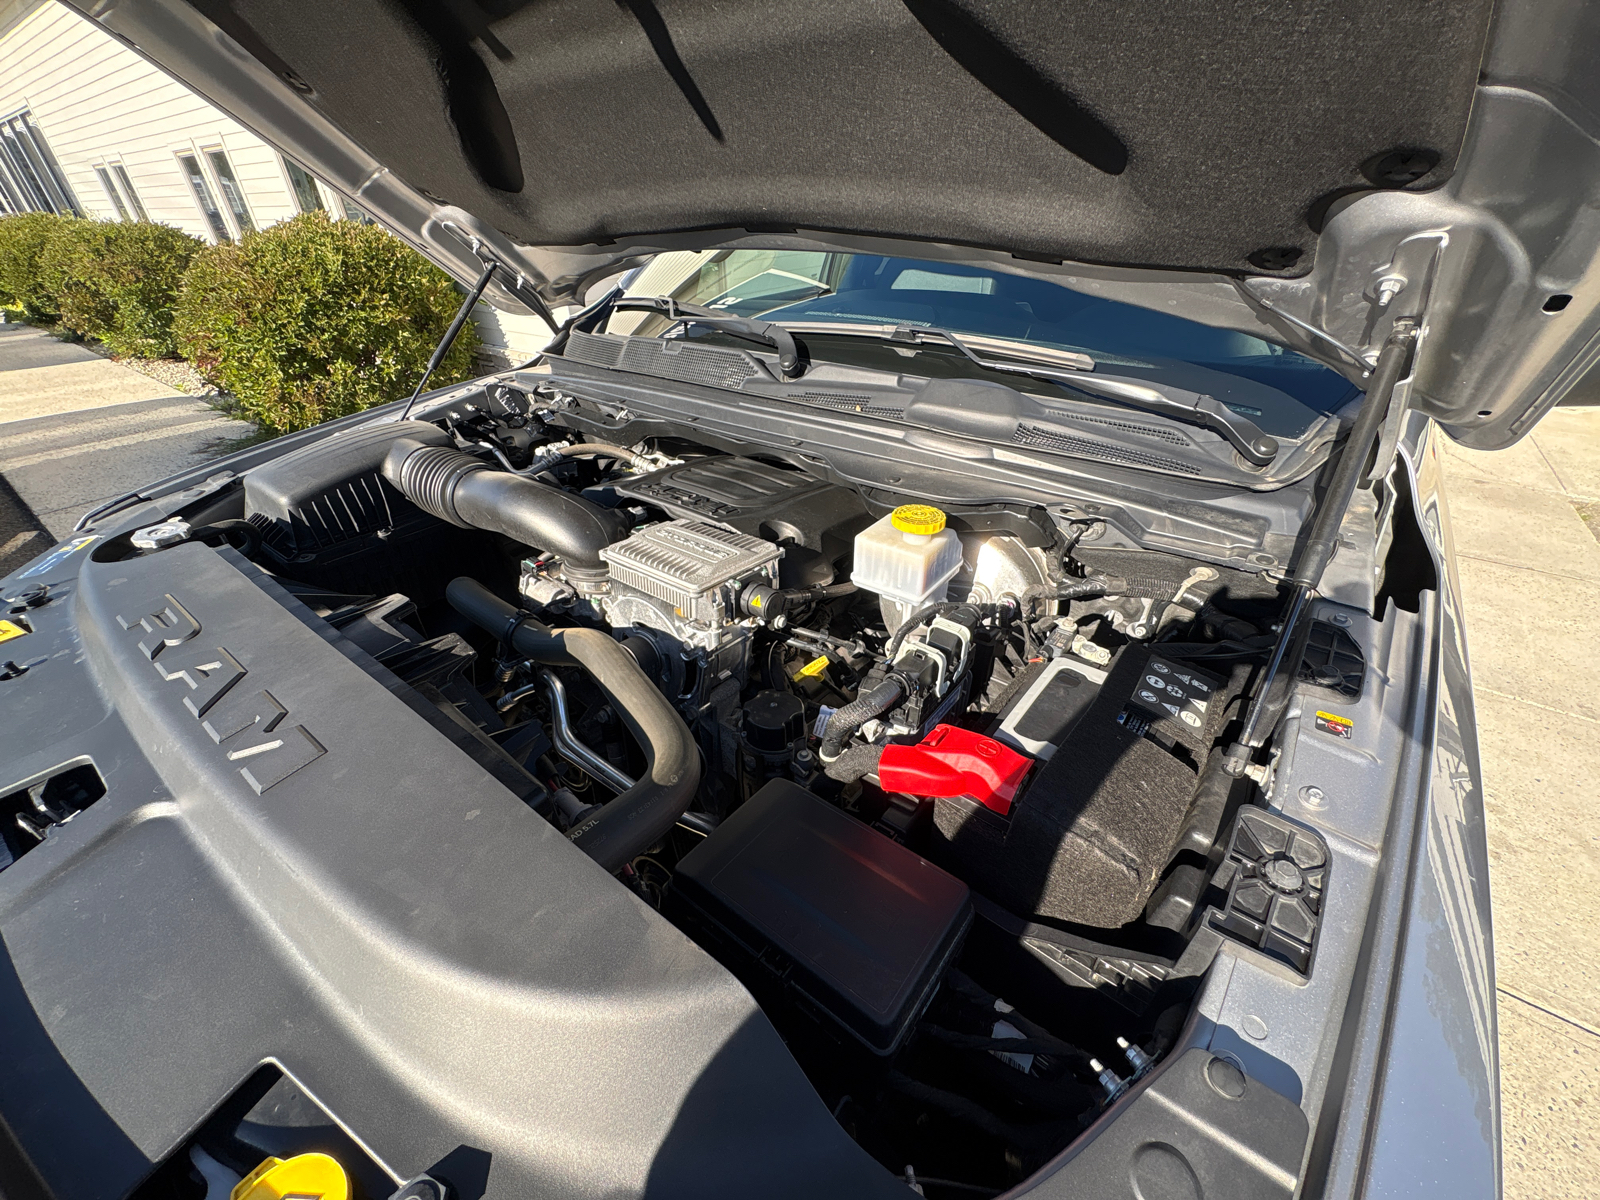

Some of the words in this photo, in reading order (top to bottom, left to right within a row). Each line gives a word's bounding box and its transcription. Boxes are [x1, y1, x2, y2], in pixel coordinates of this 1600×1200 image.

[116, 593, 328, 796] RAM
[569, 828, 583, 842] AD
[582, 819, 600, 832] 5.7L
